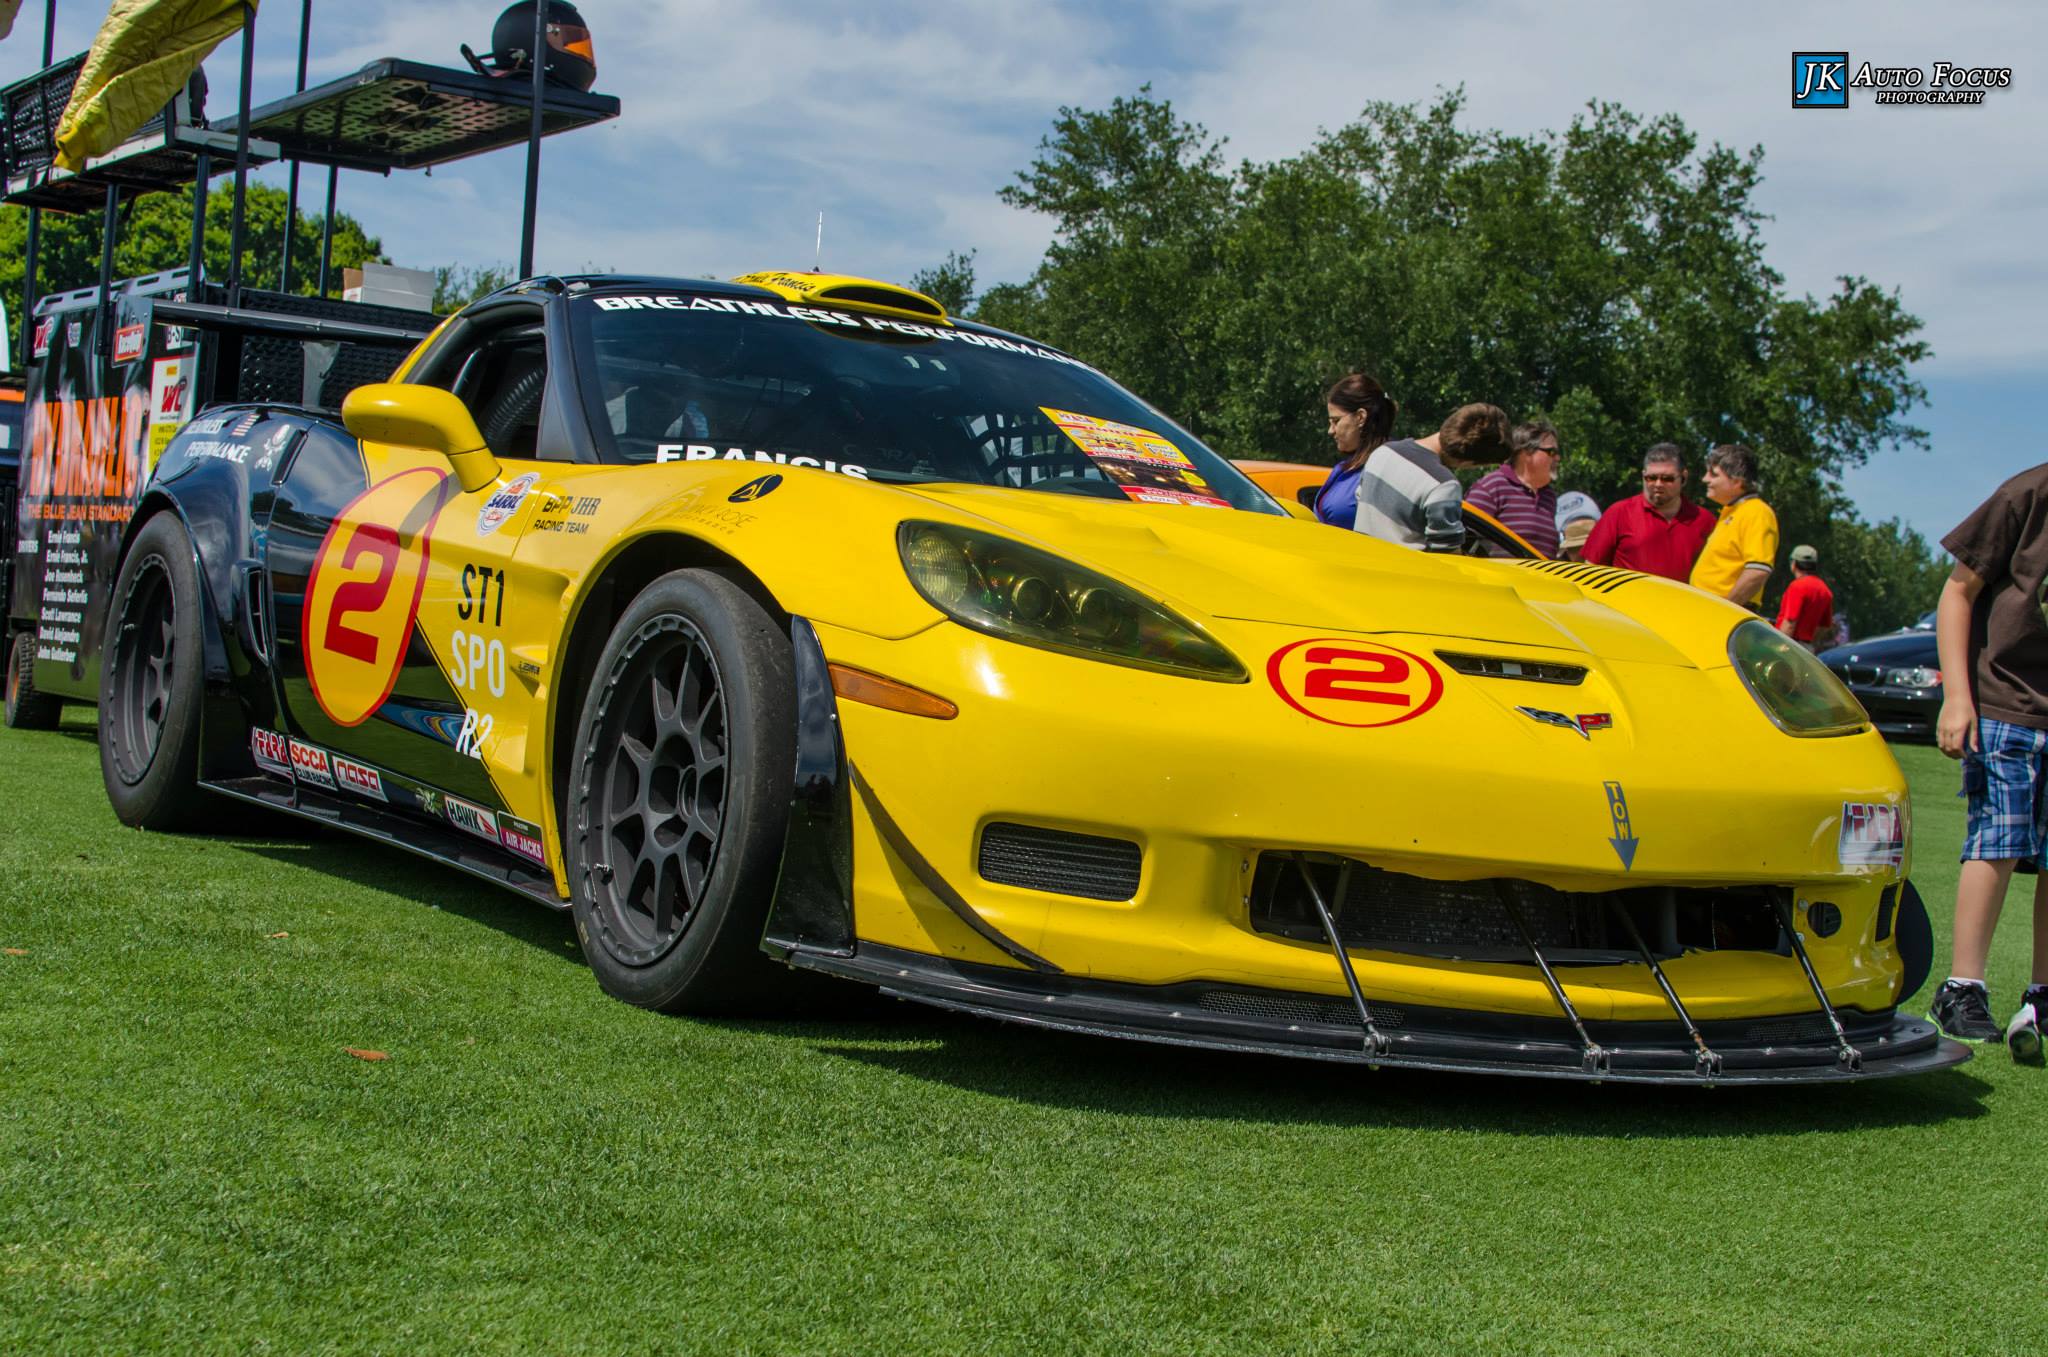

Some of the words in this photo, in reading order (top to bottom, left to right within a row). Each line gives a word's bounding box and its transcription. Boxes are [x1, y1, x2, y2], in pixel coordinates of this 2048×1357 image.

[593, 296, 861, 327] BREATHLESS
[863, 315, 1090, 372] PERFORMAN
[30, 395, 142, 499] HYDRAULIC
[27, 503, 41, 519] THE
[43, 504, 65, 520] BLUE
[67, 504, 87, 520] JEAN
[533, 519, 564, 532] RACING
[565, 521, 590, 535] TEAM
[18, 539, 38, 554] DRIVERS
[44, 569, 55, 582] Joe
[324, 522, 401, 665] 2
[458, 563, 504, 627] ST1
[1304, 647, 1411, 706] 2
[455, 708, 494, 760] R2
[291, 743, 328, 773] SCCA
[446, 799, 482, 832] HAWK
[1605, 783, 1629, 840] TOW
[505, 831, 519, 849] AIR
[519, 837, 543, 859] JACKS
